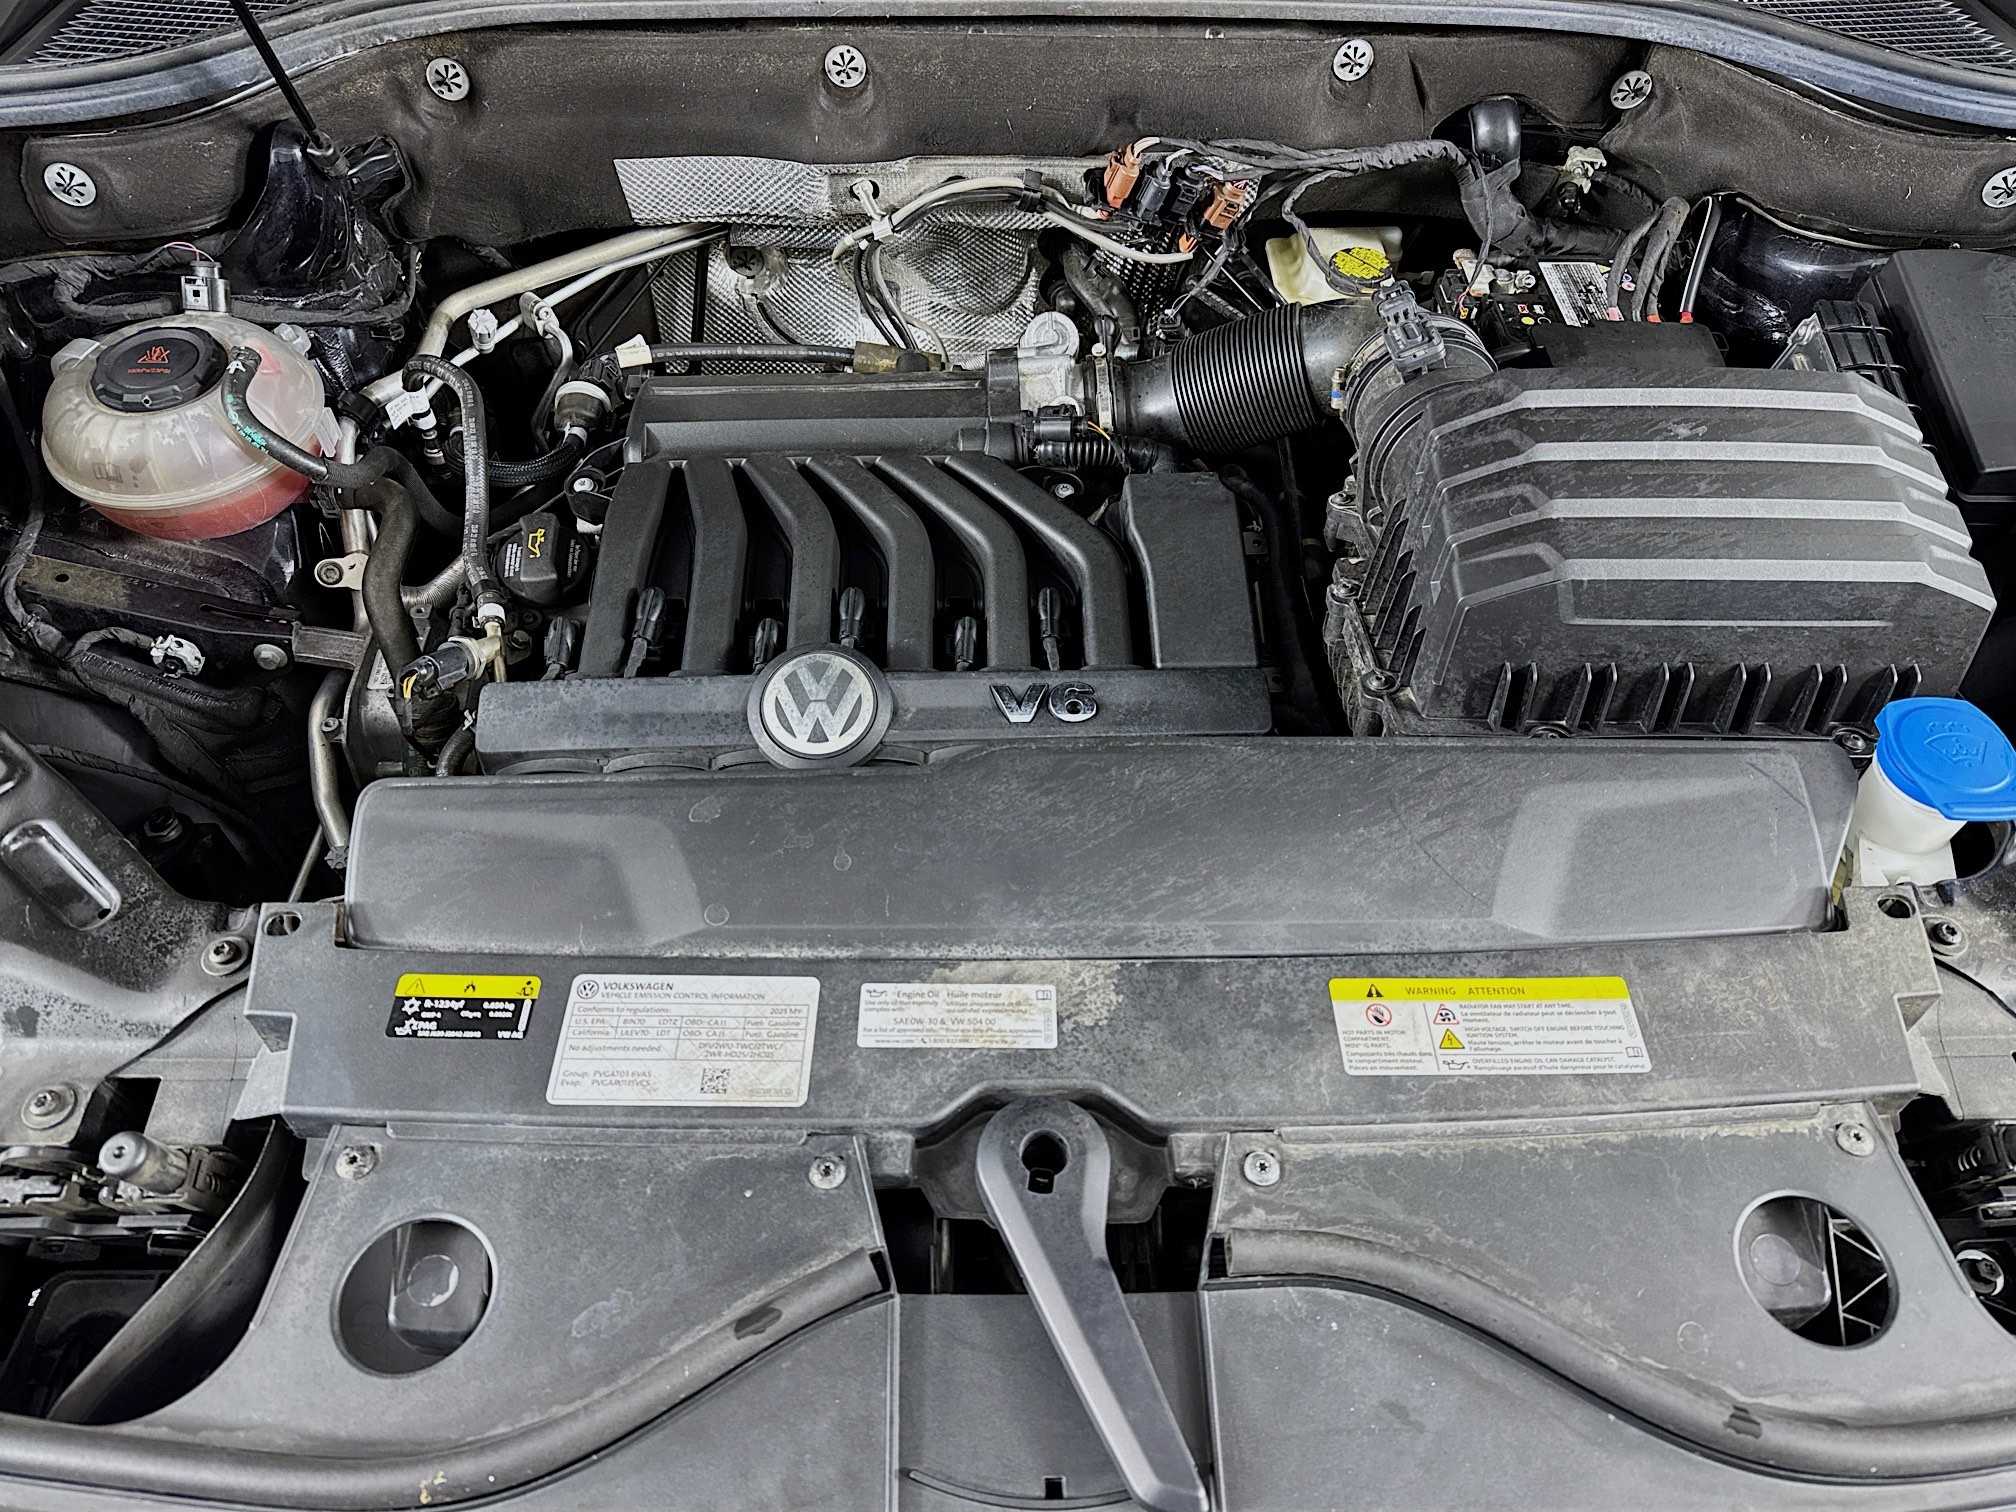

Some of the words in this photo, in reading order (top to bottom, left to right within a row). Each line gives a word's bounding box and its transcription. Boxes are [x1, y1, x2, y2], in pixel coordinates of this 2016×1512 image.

[989, 681, 1099, 723] V6
[603, 982, 674, 991] VOLKSWAGEN
[1405, 987, 1456, 995] WARNING
[1468, 986, 1526, 995] ATTENTION
[897, 990, 926, 999] Engine
[927, 990, 940, 998] Oil
[577, 1005, 614, 1013] Conforms
[768, 1018, 801, 1027] Gasoline
[766, 1029, 799, 1038] Gasoline
[569, 1044, 581, 1052] No
[582, 1044, 630, 1053] adjustments
